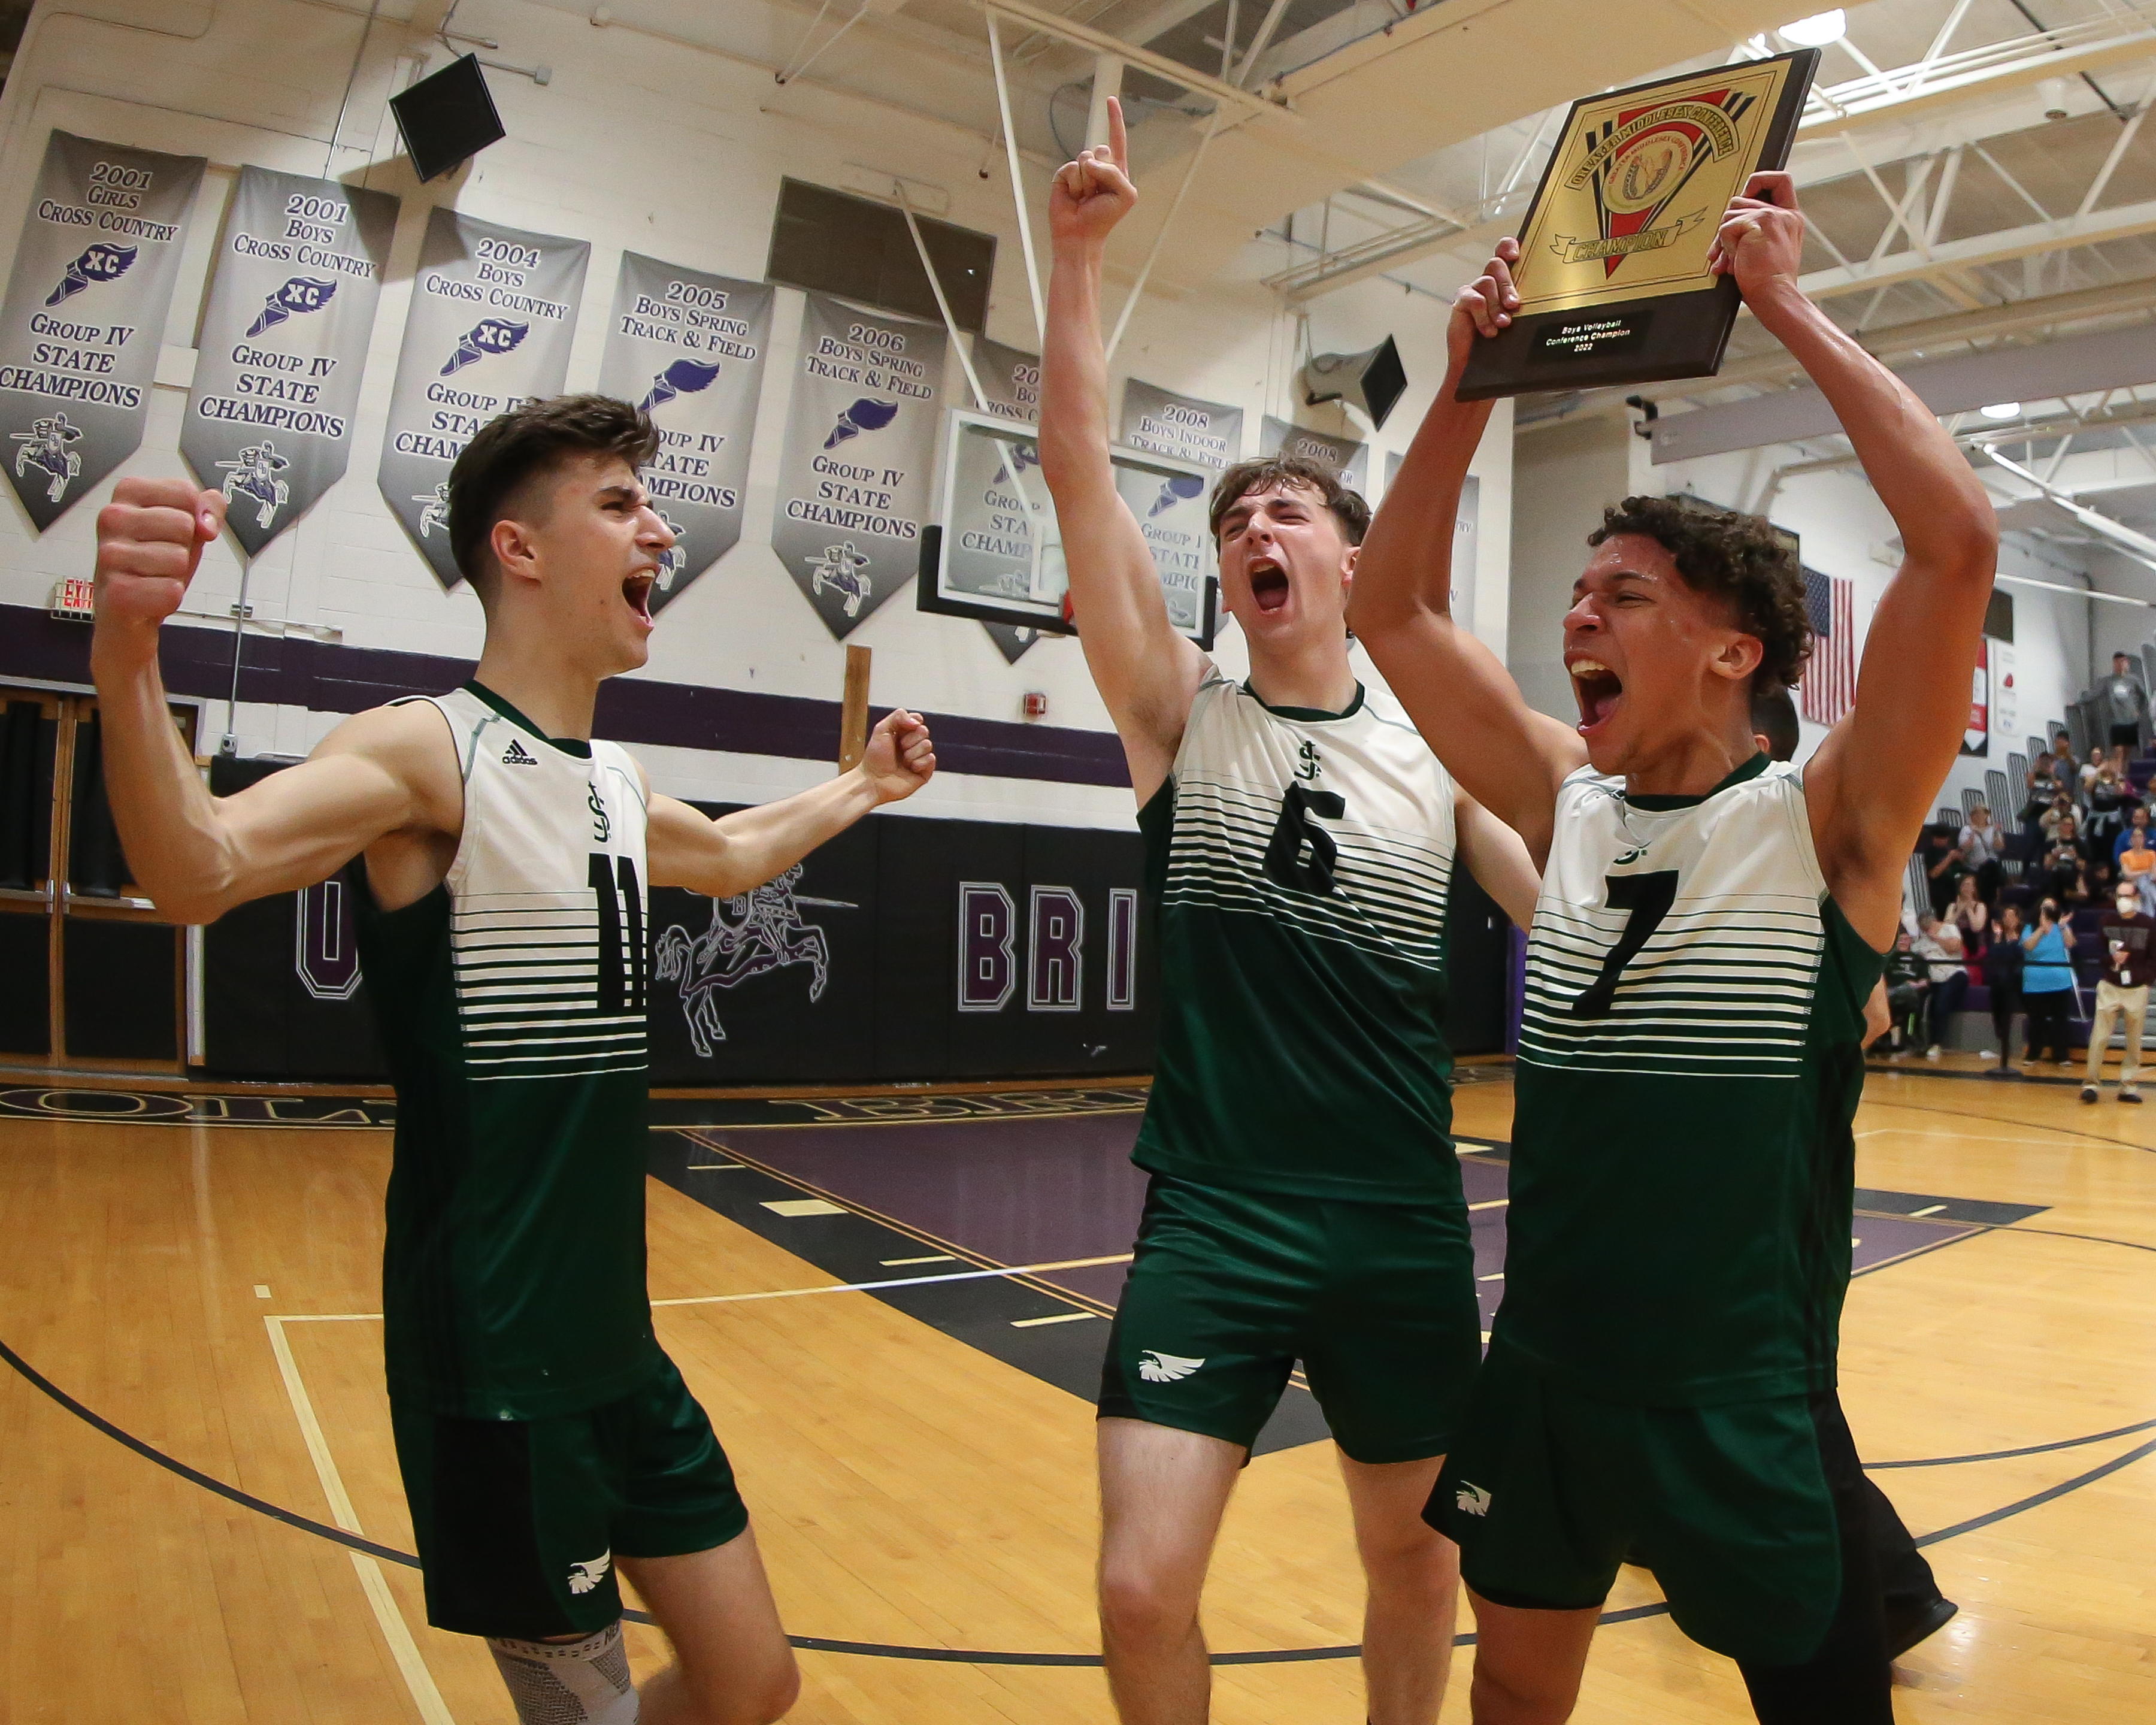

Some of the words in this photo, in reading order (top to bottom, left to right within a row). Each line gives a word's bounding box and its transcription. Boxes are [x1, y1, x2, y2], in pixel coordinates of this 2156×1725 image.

[91, 163, 152, 189] 2001
[287, 195, 347, 223] 2001
[477, 240, 539, 268] 2004
[1573, 229, 1669, 261] CHAMPION
[85, 250, 119, 273] XC
[285, 283, 320, 305] XC
[666, 283, 727, 309] 2005
[105, 326, 134, 346] IV
[479, 325, 511, 347] XC
[684, 331, 700, 348] &
[849, 325, 904, 351] 2006
[33, 343, 116, 373] STATE
[308, 358, 337, 376] IV
[0, 367, 140, 407] CHAMPIONS
[237, 374, 319, 404] STATE
[865, 370, 881, 388] &
[199, 397, 344, 437] CHAMPIONS
[1164, 405, 1209, 429] 2008
[697, 434, 725, 453] IV
[881, 470, 904, 487] IV
[817, 481, 891, 509] STATE
[787, 500, 916, 538] CHAMPIONS
[502, 755, 538, 765] adidas
[1263, 780, 1345, 898] 6
[588, 853, 644, 1012] 11
[1572, 869, 1679, 1017] 7
